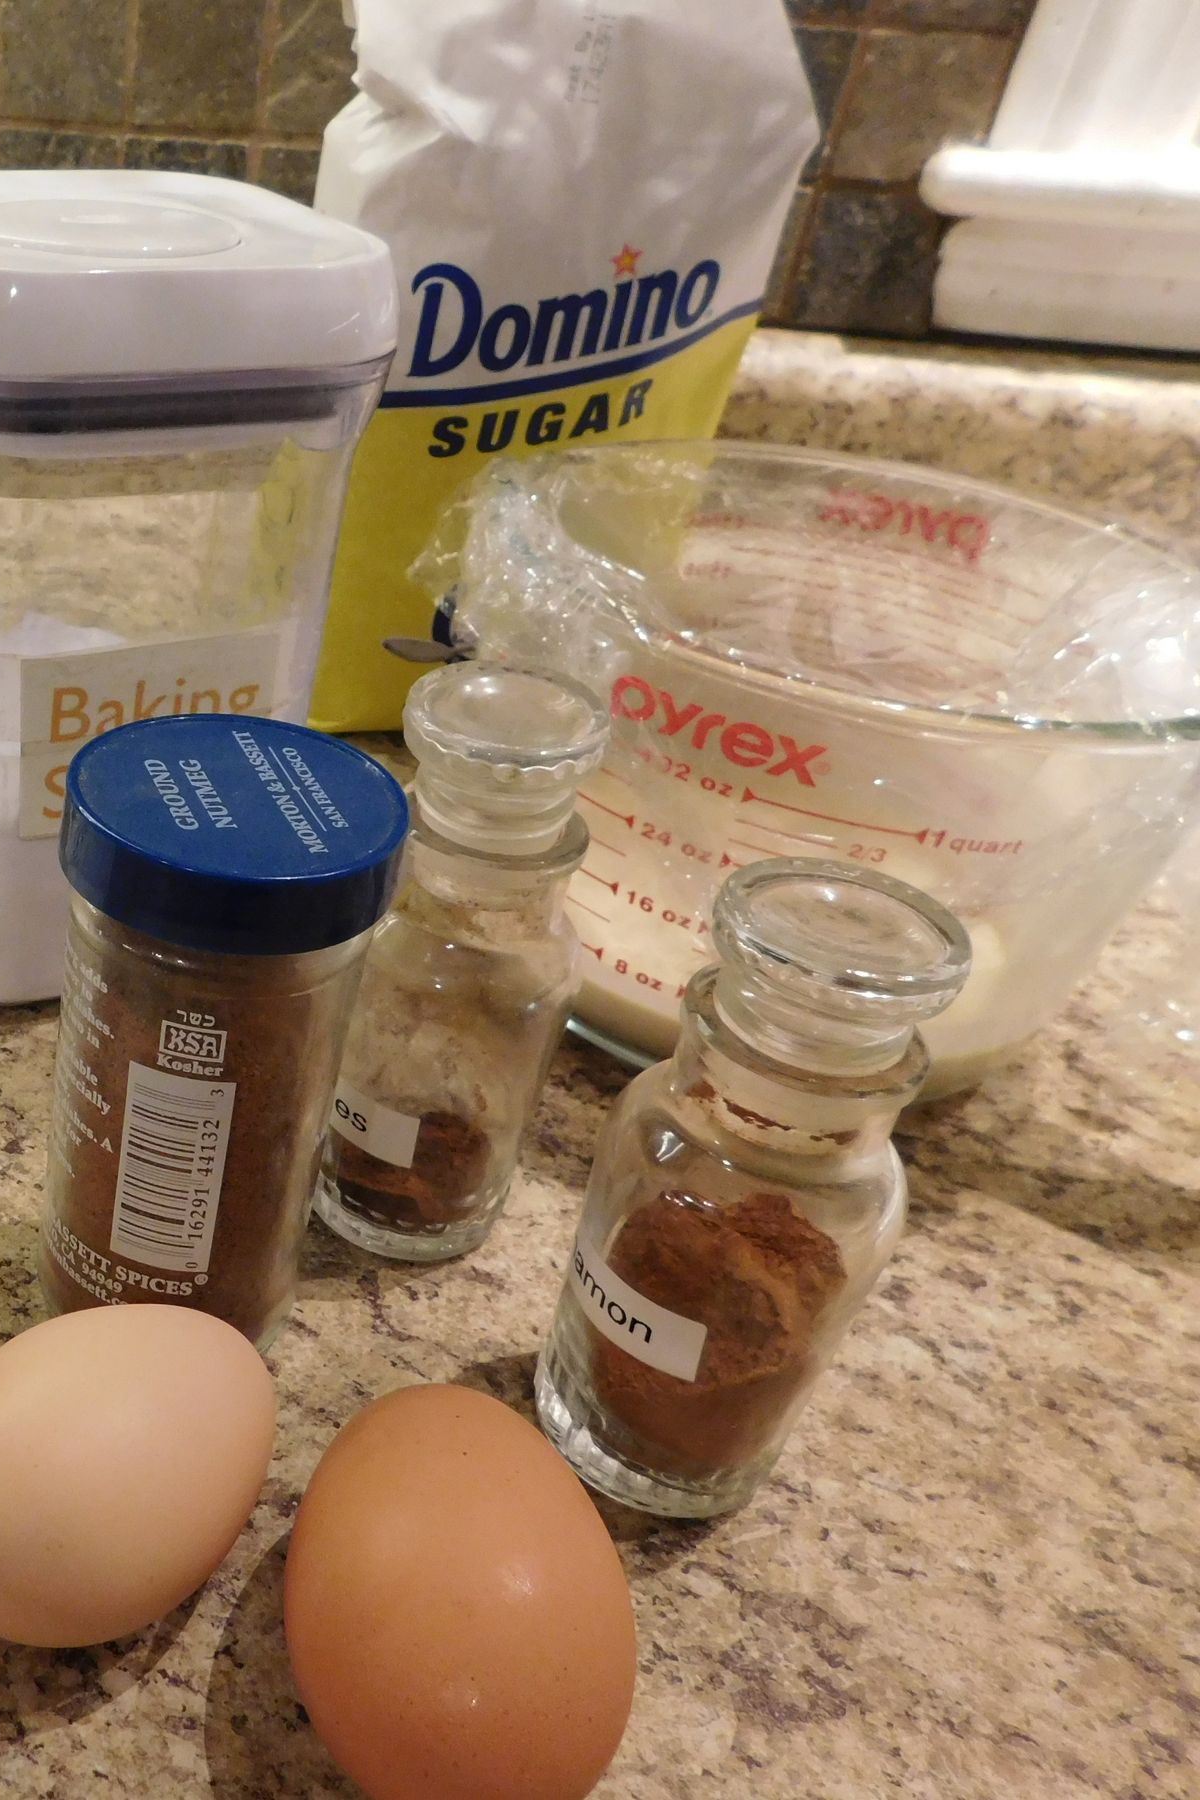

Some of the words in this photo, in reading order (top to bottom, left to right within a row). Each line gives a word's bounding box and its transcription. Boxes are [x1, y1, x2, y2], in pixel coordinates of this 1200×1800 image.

[407, 252, 721, 377] Domino
[427, 377, 654, 458] SUGAR
[49, 677, 261, 744] Baking
[610, 675, 829, 788] pyrex
[232, 730, 279, 782] BASSETT
[282, 747, 333, 806] FRANCISCO
[144, 758, 200, 832] GROUND
[178, 758, 238, 831] NUTMEG
[700, 776, 733, 798] oz
[272, 794, 329, 854] MORTON
[320, 805, 350, 829] SAN
[847, 843, 888, 863] 2/3
[949, 837, 1024, 855] quart
[627, 890, 654, 913] 16
[661, 909, 692, 930] oz
[79, 964, 109, 994] adds
[614, 958, 628, 975] 8
[635, 972, 663, 992] oz
[167, 1027, 218, 1057] KSA
[176, 1009, 216, 1027] כשר
[156, 1052, 224, 1077] Kosher
[334, 1098, 368, 1133] es
[100, 1137, 114, 1153] A
[200, 1118, 221, 1178] 44132
[188, 1186, 211, 1241] 16291
[52, 1217, 112, 1273] ASSETT
[115, 1265, 194, 1297] SPICES
[61, 1242, 76, 1266] CA
[81, 1262, 123, 1294] 94949
[574, 1250, 653, 1344] amon
